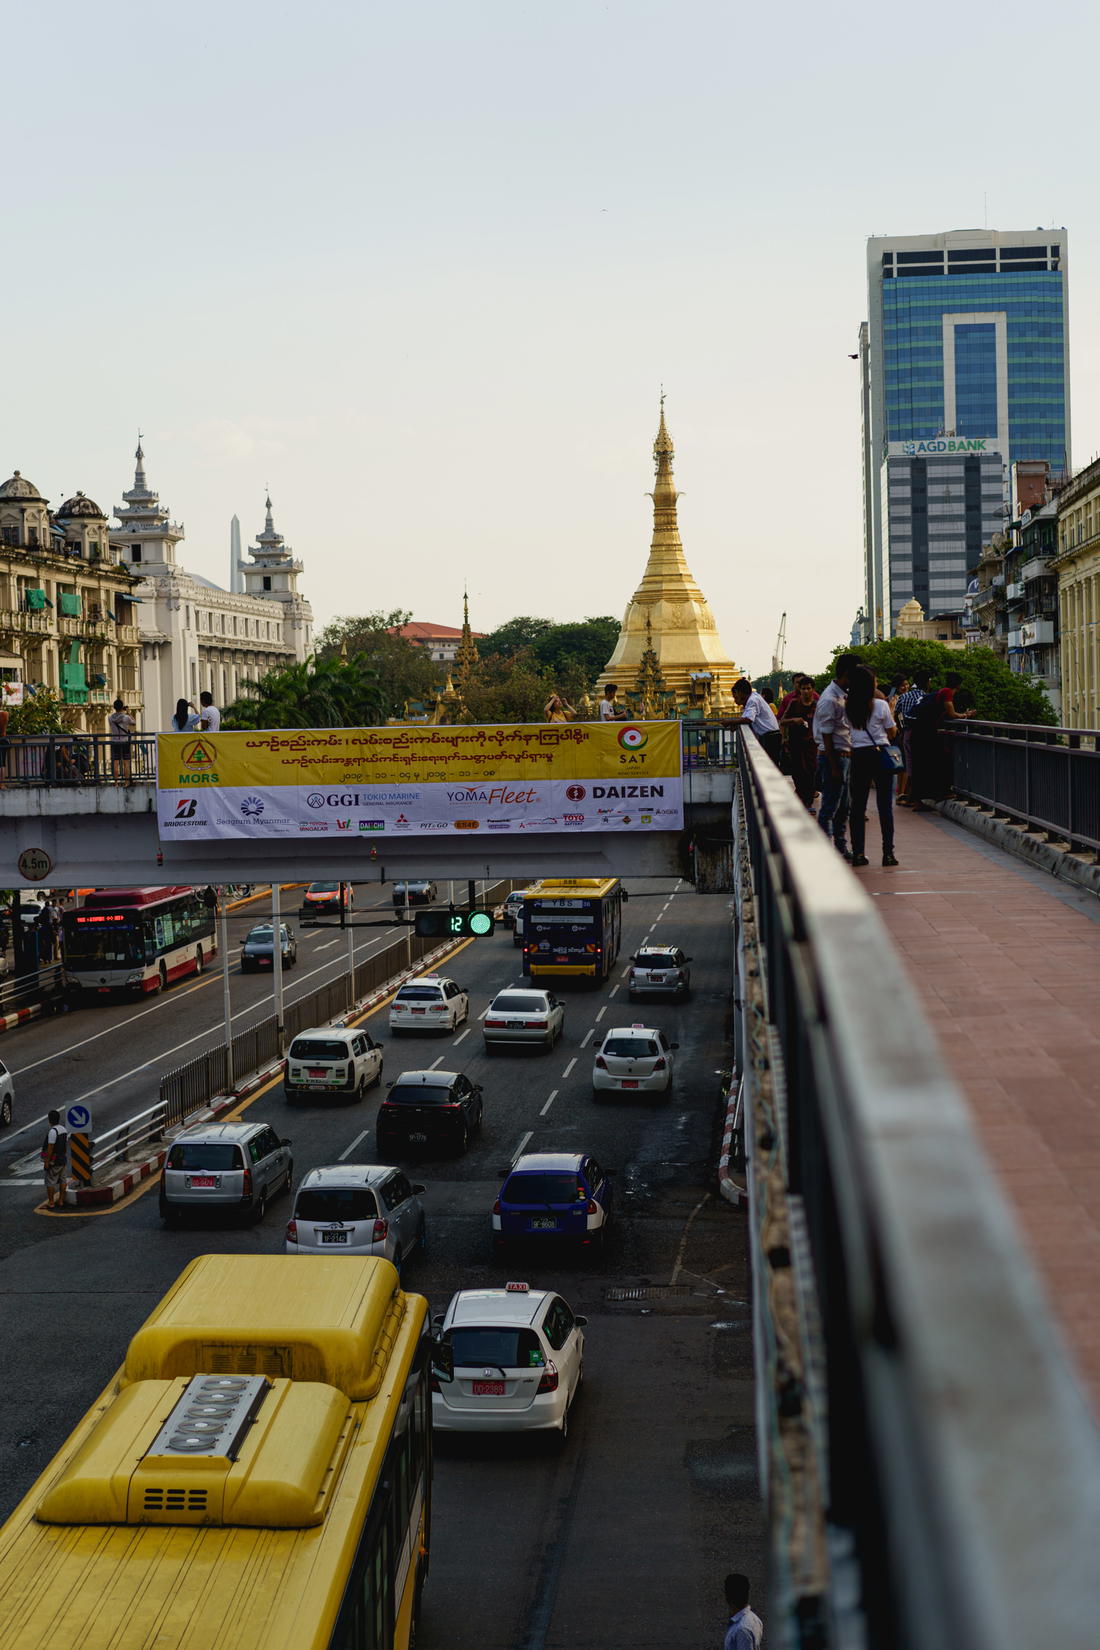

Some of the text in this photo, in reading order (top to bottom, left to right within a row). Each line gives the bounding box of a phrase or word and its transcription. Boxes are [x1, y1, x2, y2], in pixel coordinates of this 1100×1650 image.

[917, 440, 986, 452] AGD BANK
[619, 754, 647, 764] SAT
[179, 774, 219, 784] MORS
[363, 792, 421, 801] TOKIO MARINE
[447, 786, 538, 805] YOMA Fleet
[593, 785, 664, 799] DAIZEN
[326, 793, 360, 807] GGI
[21, 858, 48, 869] 4.5m
[552, 899, 573, 907] YBS
[450, 916, 462, 932] 12
